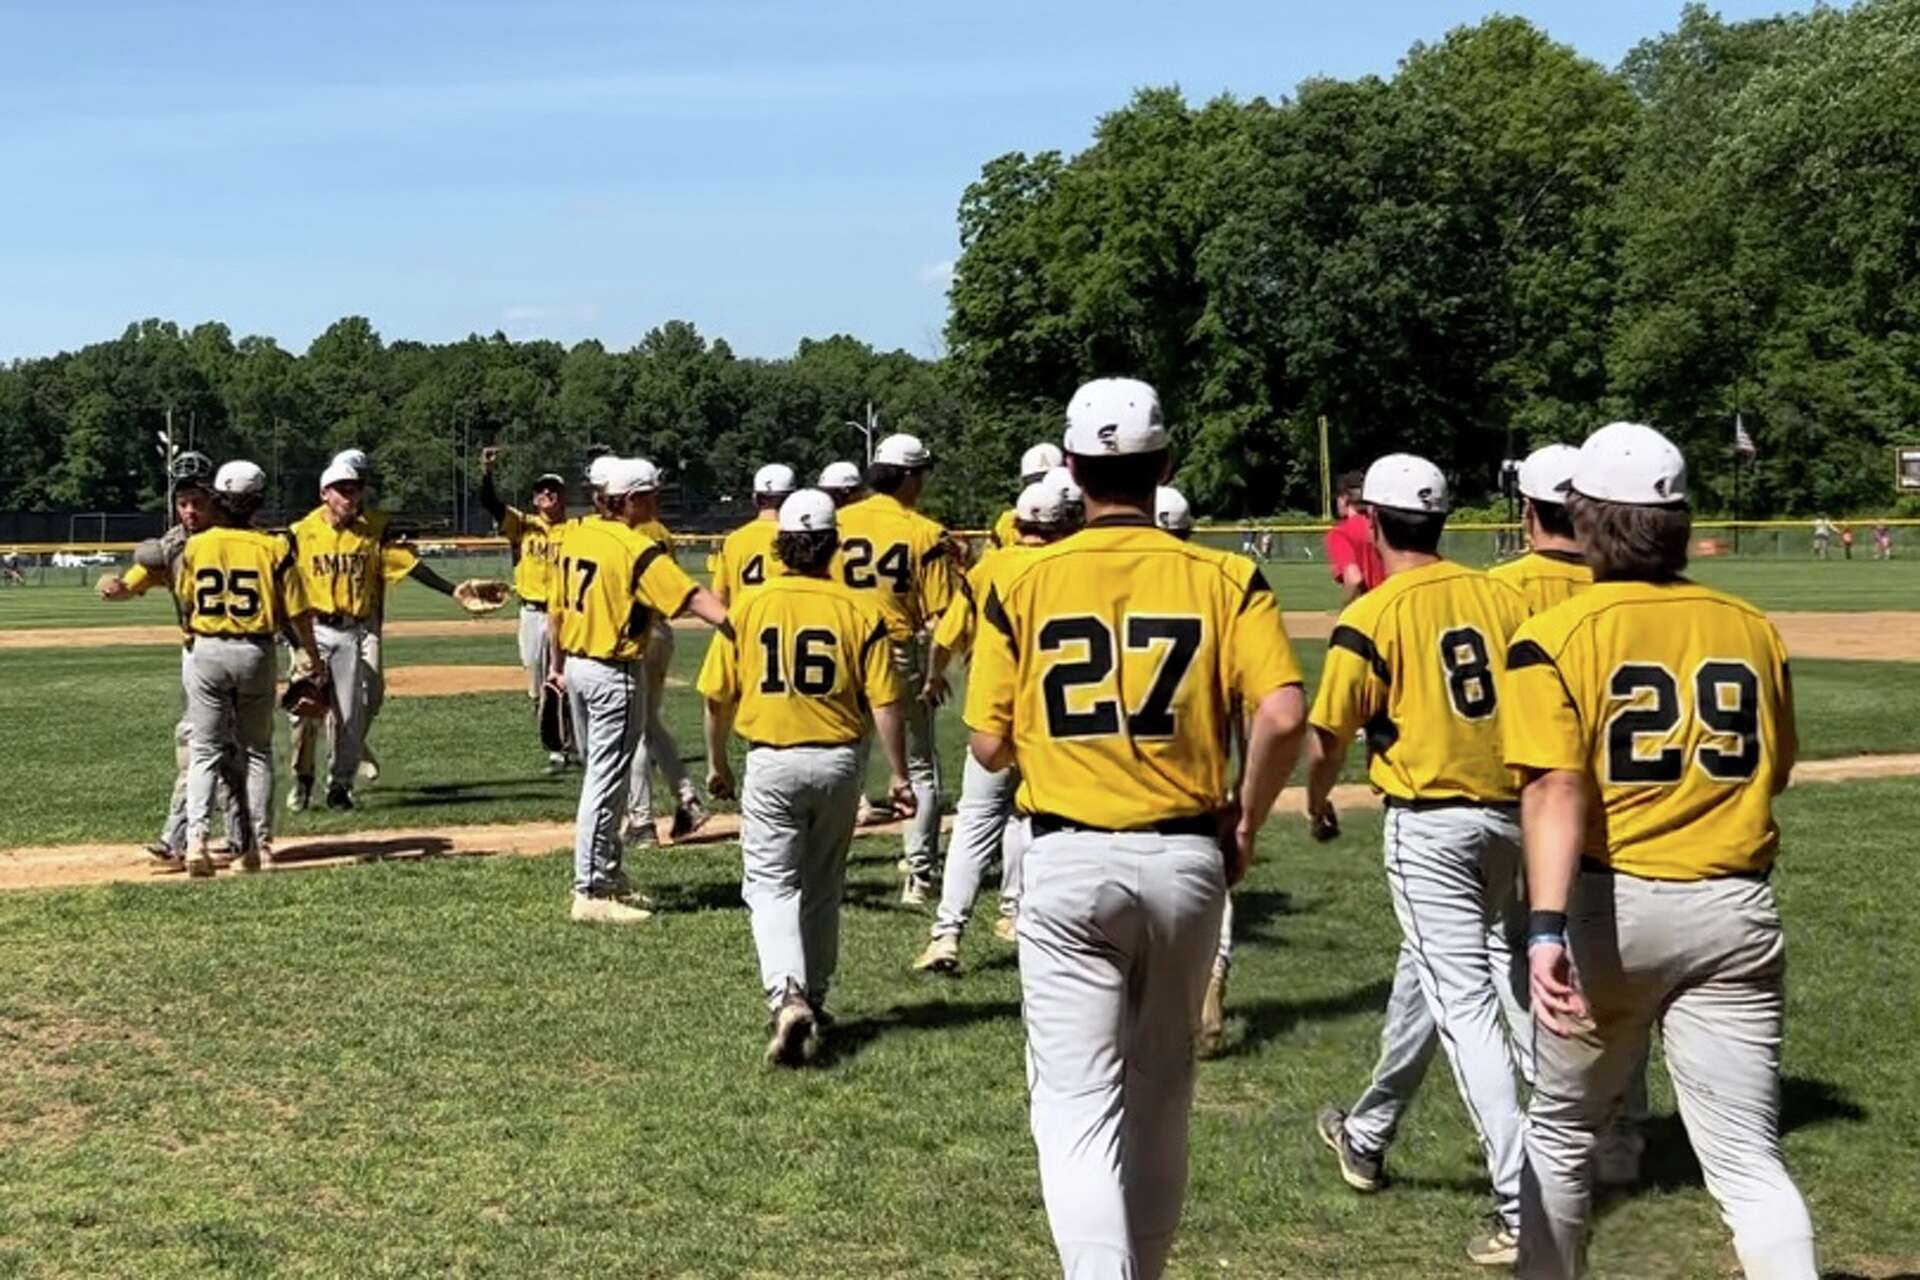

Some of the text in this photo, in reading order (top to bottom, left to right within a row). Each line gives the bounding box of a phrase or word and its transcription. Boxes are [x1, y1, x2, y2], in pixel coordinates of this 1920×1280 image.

[195, 567, 260, 617] 25
[562, 556, 599, 614] 17
[842, 536, 911, 593] 24
[759, 626, 838, 697] 16
[1036, 614, 1203, 739] 27
[1439, 625, 1498, 719] 8
[1606, 660, 1762, 784] 29
